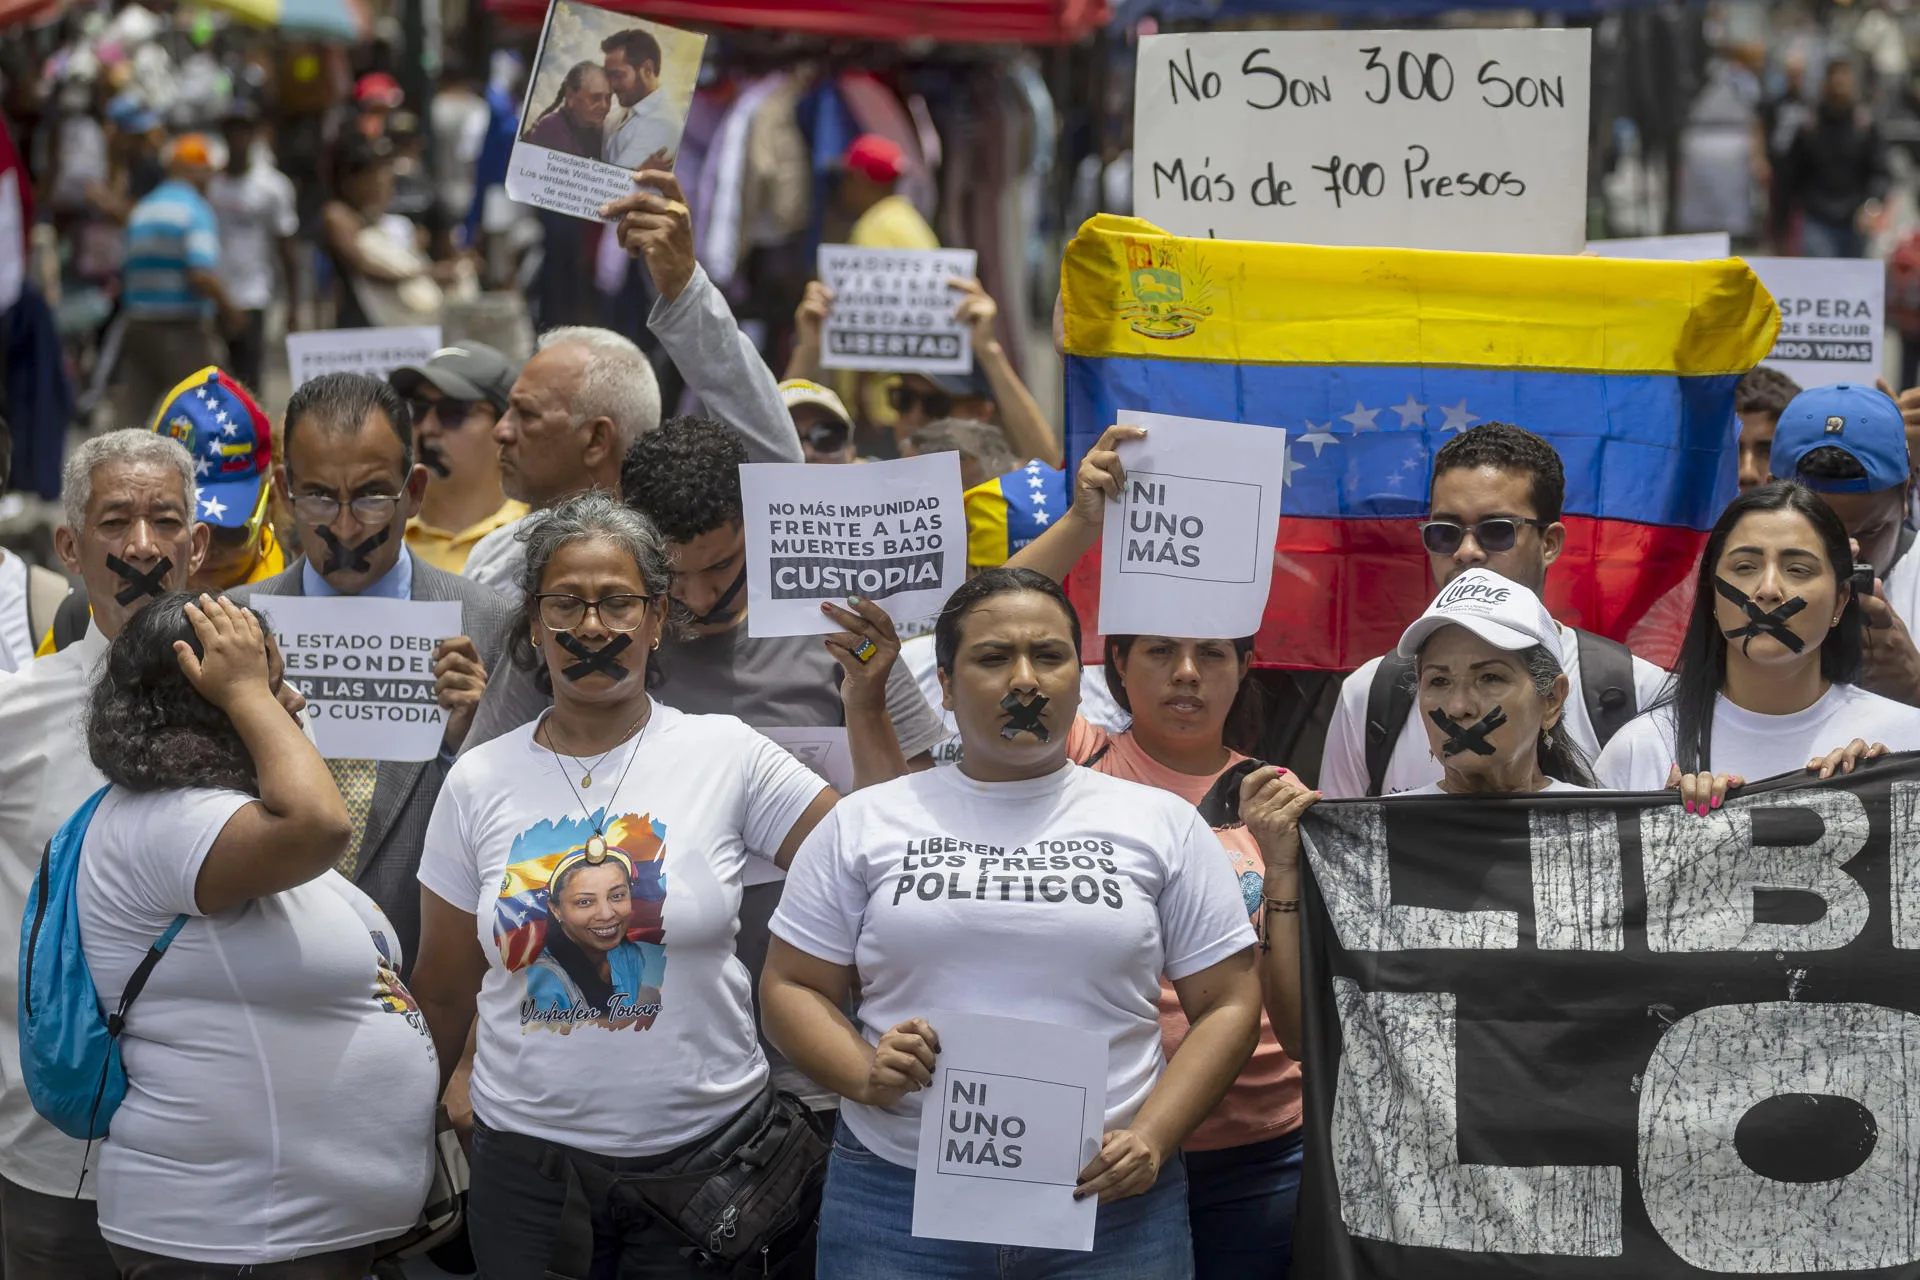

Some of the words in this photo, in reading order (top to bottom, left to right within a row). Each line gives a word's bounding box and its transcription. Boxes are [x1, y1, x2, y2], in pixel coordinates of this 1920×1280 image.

[1169, 48, 1221, 104] No
[1359, 46, 1454, 104] 300
[546, 164, 570, 177] Tarek
[573, 170, 605, 184] William
[607, 178, 630, 191] Saab
[547, 152, 590, 169] Diosdado
[591, 163, 626, 179] Cabello
[1152, 156, 1235, 202] Más
[1251, 162, 1296, 206] de
[1311, 155, 1385, 208] 700
[1404, 145, 1526, 199] Presos
[520, 168, 537, 179] Los
[538, 174, 588, 192] verdaderos
[544, 185, 556, 195] de
[558, 190, 582, 202] estas
[1779, 297, 1872, 318] SPERA
[1807, 322, 1870, 337] SEGUIR
[833, 334, 958, 356] LIBERTAD
[1770, 343, 1812, 359] NDO
[1815, 344, 1871, 360] VIDAS
[1132, 481, 1165, 506] NI
[769, 503, 794, 515] NO
[800, 501, 836, 517] MÁS
[840, 497, 940, 518] IMPUNIDAD
[770, 520, 861, 538] FRENTE
[873, 522, 888, 536] A
[900, 514, 942, 534] LAS
[1130, 510, 1204, 539] UNO
[771, 539, 874, 557] MUERTES
[883, 534, 943, 555] BAJO
[1127, 537, 1201, 568] MÁS
[775, 561, 939, 592] CUSTODIA
[297, 634, 382, 649] ESTADO
[286, 653, 437, 673] ESPONDE
[323, 681, 364, 698] LAS
[329, 704, 441, 724] CUSTODIA
[907, 837, 1005, 857] LIBEREN
[1012, 846, 1029, 856] A
[1035, 840, 1115, 856] TODOS
[903, 855, 967, 871] LOS
[979, 855, 1118, 874] PRESOS
[1300, 782, 1920, 952] LIB
[892, 870, 1124, 910] POLÍTICOS
[607, 993, 663, 1024] Tovar
[952, 1080, 986, 1106] NI
[949, 1110, 1026, 1139] UNO
[945, 1137, 1022, 1168] MÁS
